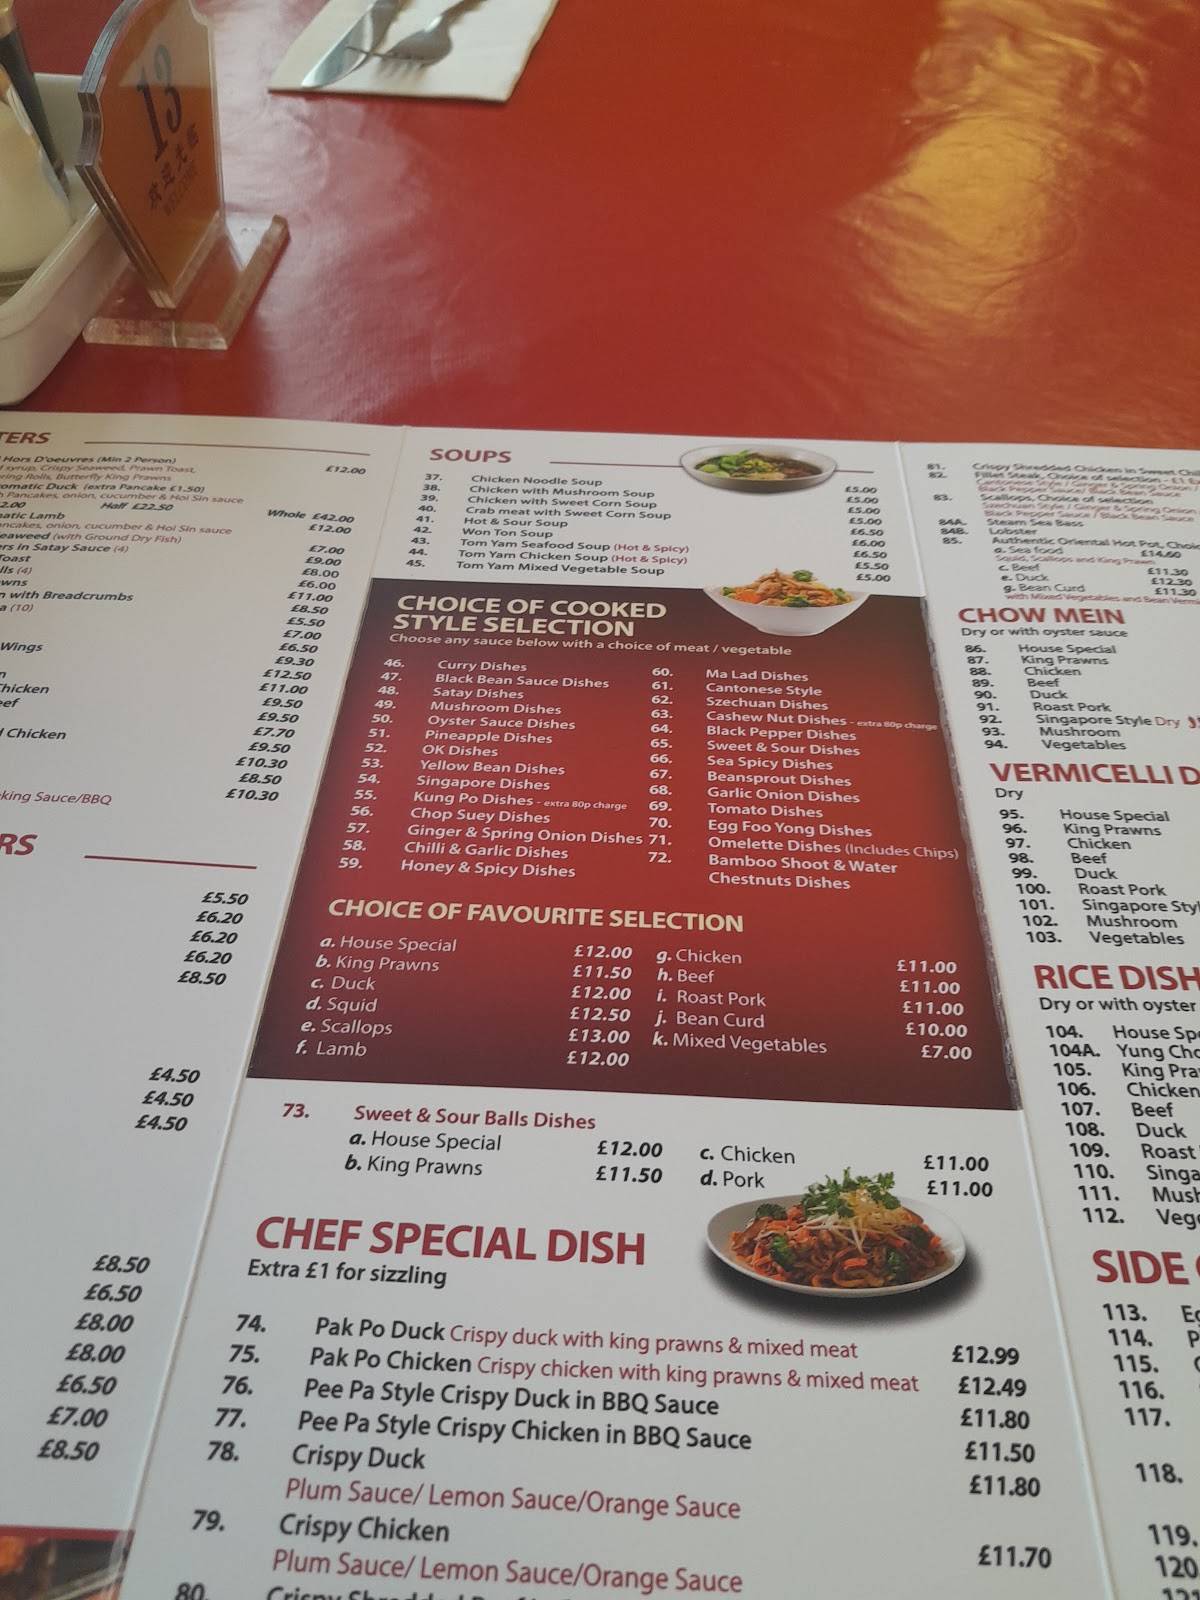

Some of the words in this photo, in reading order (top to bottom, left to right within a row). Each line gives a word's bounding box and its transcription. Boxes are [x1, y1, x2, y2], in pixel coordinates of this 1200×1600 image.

[137, 45, 181, 161] 13
[429, 448, 511, 463] SOUPS
[424, 473, 442, 481] 37.
[471, 474, 520, 483] Chicken
[523, 476, 568, 485] Noodle
[571, 478, 602, 487] Soup
[99, 501, 129, 509] Half
[131, 502, 174, 511] £22.50
[267, 509, 306, 518] Whole
[311, 512, 355, 523] £42.00
[464, 517, 487, 525] Hot
[489, 517, 499, 525] &
[502, 518, 532, 526] Sour
[535, 518, 568, 528] Soup
[52, 532, 82, 540] (with
[84, 533, 129, 542] Ground
[130, 534, 152, 544] Dry
[154, 535, 184, 544] Fish)
[850, 528, 884, 536] £6.50
[989, 526, 1037, 536] Lobster
[410, 536, 429, 544] 43.
[460, 538, 487, 546] Tom
[490, 539, 517, 547] Yam
[521, 540, 574, 549] Seafood
[577, 542, 610, 552] Soup
[613, 543, 638, 551] (Hot
[641, 544, 650, 552] &
[654, 544, 689, 554] Spicy)
[853, 550, 887, 558] £6.50
[405, 559, 425, 567] 45.
[456, 560, 484, 569] Tom
[487, 561, 514, 570] Yam
[518, 562, 558, 571] Mixed
[561, 564, 627, 574] Vegetable
[630, 566, 664, 576] Soup
[297, 579, 336, 590] £6.00
[856, 573, 891, 582] £5.00
[9, 590, 39, 599] with
[42, 590, 133, 601] Breadcrumbs
[397, 595, 501, 613] CHOICE
[506, 598, 544, 614] OF
[550, 600, 666, 619] COOKED
[958, 607, 1046, 623] CHOW
[1053, 607, 1125, 624] MEIN
[392, 613, 477, 631] STYLE
[482, 616, 634, 637] SELECTION
[961, 627, 986, 637] Dry
[1007, 626, 1039, 635] with
[1042, 628, 1085, 638] oyster
[1088, 629, 1128, 637] sauce
[1, 642, 43, 654] Wings
[389, 632, 441, 643] Choose
[444, 637, 470, 646] any
[473, 638, 512, 646] sauce
[516, 637, 559, 647] below
[562, 639, 592, 648] with
[596, 640, 605, 648] a
[607, 640, 653, 650] choice
[656, 642, 671, 650] of
[674, 643, 709, 652] meat
[712, 644, 719, 653] /
[721, 645, 792, 655] vegetable
[964, 644, 986, 653] 86.
[1018, 644, 1063, 653] House
[1065, 644, 1116, 655] Special
[383, 658, 404, 667] 46.
[437, 659, 477, 672] Curry
[480, 661, 527, 671] Dishes
[262, 668, 312, 680] £12.50
[652, 667, 673, 676] 60.
[706, 669, 727, 679] Ma
[731, 670, 757, 680] Lad
[761, 671, 808, 681] Dishes
[650, 709, 673, 719] 63.
[706, 710, 763, 722] Cashew
[766, 713, 794, 723] Nut
[797, 714, 847, 725] Dishes
[978, 714, 1002, 723] 92.
[1035, 714, 1112, 726] Singapore
[1115, 715, 1152, 727] Style
[1154, 716, 1180, 728] Dry
[367, 728, 390, 738] 51.
[425, 729, 500, 743] Pineapple
[503, 732, 552, 743] Dishes
[235, 756, 288, 769] £10.30
[989, 763, 1174, 784] VERMICELLI
[33, 791, 112, 805] Sauce/BBQ
[346, 822, 369, 833] 57.
[407, 824, 462, 839] Ginger
[465, 826, 477, 837] &
[481, 826, 533, 842] Spring
[537, 829, 587, 841] Onion
[591, 831, 642, 844] Dishes
[649, 834, 671, 845] 71.
[708, 836, 783, 850] Omelette
[787, 839, 841, 853] Dishes
[845, 843, 910, 856] (Includes
[913, 846, 959, 860] Chips)
[201, 891, 249, 905] £5.50
[327, 898, 423, 918] CHOICE
[427, 902, 462, 920] OF
[467, 903, 603, 926] FAVOURITE
[608, 909, 743, 932] SELECTION
[1022, 914, 1058, 926] 102.
[1086, 914, 1178, 928] Mushroom
[319, 936, 335, 948] a.
[340, 935, 393, 950] House
[397, 937, 456, 953] Special
[574, 944, 632, 959] £12.00
[656, 950, 672, 964] g.
[676, 948, 741, 963] Chicken
[897, 959, 957, 974] £11.00
[1033, 964, 1114, 989] RICE
[1045, 1025, 1083, 1038] 104.
[652, 1031, 668, 1046] k.
[673, 1033, 725, 1048] Mixed
[729, 1035, 827, 1054] Vegetables
[921, 1044, 972, 1060] £7.00
[148, 1067, 200, 1083] £4.50
[282, 1103, 309, 1118] 73.
[354, 1105, 412, 1122] Sweet
[416, 1107, 431, 1123] &
[435, 1108, 480, 1124] Sour
[484, 1110, 528, 1126] Balls
[534, 1112, 595, 1129] Dishes
[1130, 1102, 1173, 1117] Beef
[1082, 1207, 1125, 1223] 112.
[256, 1216, 363, 1251] CHEF
[368, 1221, 536, 1260] SPECIAL
[547, 1229, 644, 1265] DISH
[92, 1254, 150, 1273] £8.50
[1092, 1249, 1190, 1285] SIDE
[247, 1258, 300, 1278] Extra
[305, 1261, 328, 1279] £1
[336, 1261, 366, 1280] for
[369, 1264, 446, 1289] sizzling
[1102, 1303, 1147, 1321] 113.
[235, 1314, 266, 1333] 74.
[315, 1316, 353, 1336] Pak
[358, 1318, 385, 1337] Po
[390, 1320, 445, 1341] Duck
[450, 1325, 508, 1348] Crispy
[512, 1328, 558, 1346] duck
[562, 1330, 603, 1348] with
[609, 1331, 649, 1355] king
[655, 1338, 723, 1355] prawns
[728, 1336, 742, 1353] &
[747, 1338, 804, 1356] mixed
[810, 1343, 858, 1358] meat
[952, 1344, 1020, 1365] £12.99
[46, 1406, 109, 1428] £7.00
[207, 1440, 239, 1461] 78.
[292, 1443, 363, 1472] Crispy
[367, 1446, 425, 1469] Duck
[1135, 1462, 1183, 1483] 118.
[969, 1474, 1041, 1497] £11.80
[285, 1477, 341, 1501] Plum
[347, 1480, 424, 1505] Sauce/
[428, 1484, 504, 1508] Lemon
[511, 1487, 669, 1521] Sauce/Orange
[675, 1494, 741, 1519] Sauce
